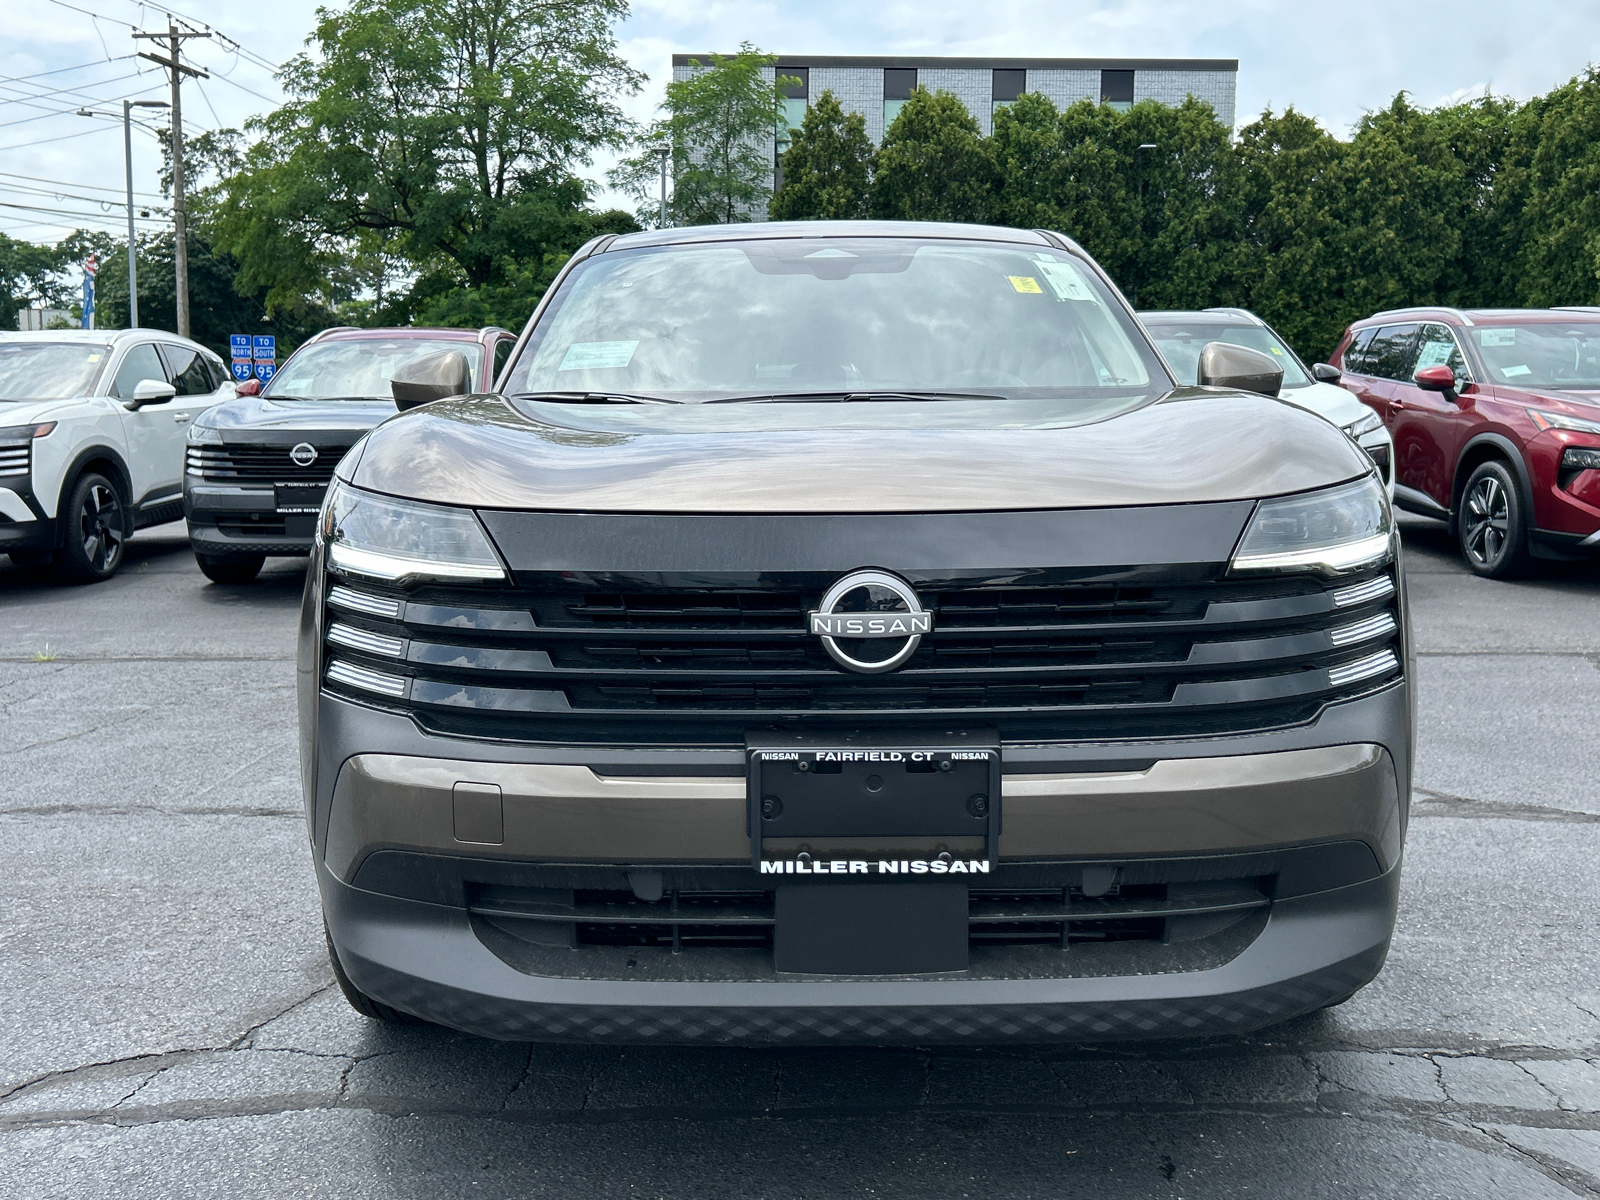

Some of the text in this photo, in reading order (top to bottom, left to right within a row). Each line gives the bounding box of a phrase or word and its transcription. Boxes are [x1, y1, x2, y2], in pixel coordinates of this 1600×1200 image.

[236, 337, 246, 345] TO
[259, 338, 269, 346] TO
[231, 348, 251, 357] NORTH
[254, 349, 274, 357] SOUTH
[235, 365, 250, 377] 95
[258, 366, 273, 378] 95
[814, 616, 928, 634] NISSAN
[761, 752, 799, 760] NISSAN
[815, 751, 935, 763] FAIRFIELD, CT
[951, 752, 989, 760] NISSAN
[760, 860, 990, 874] MILLER NISSAN
